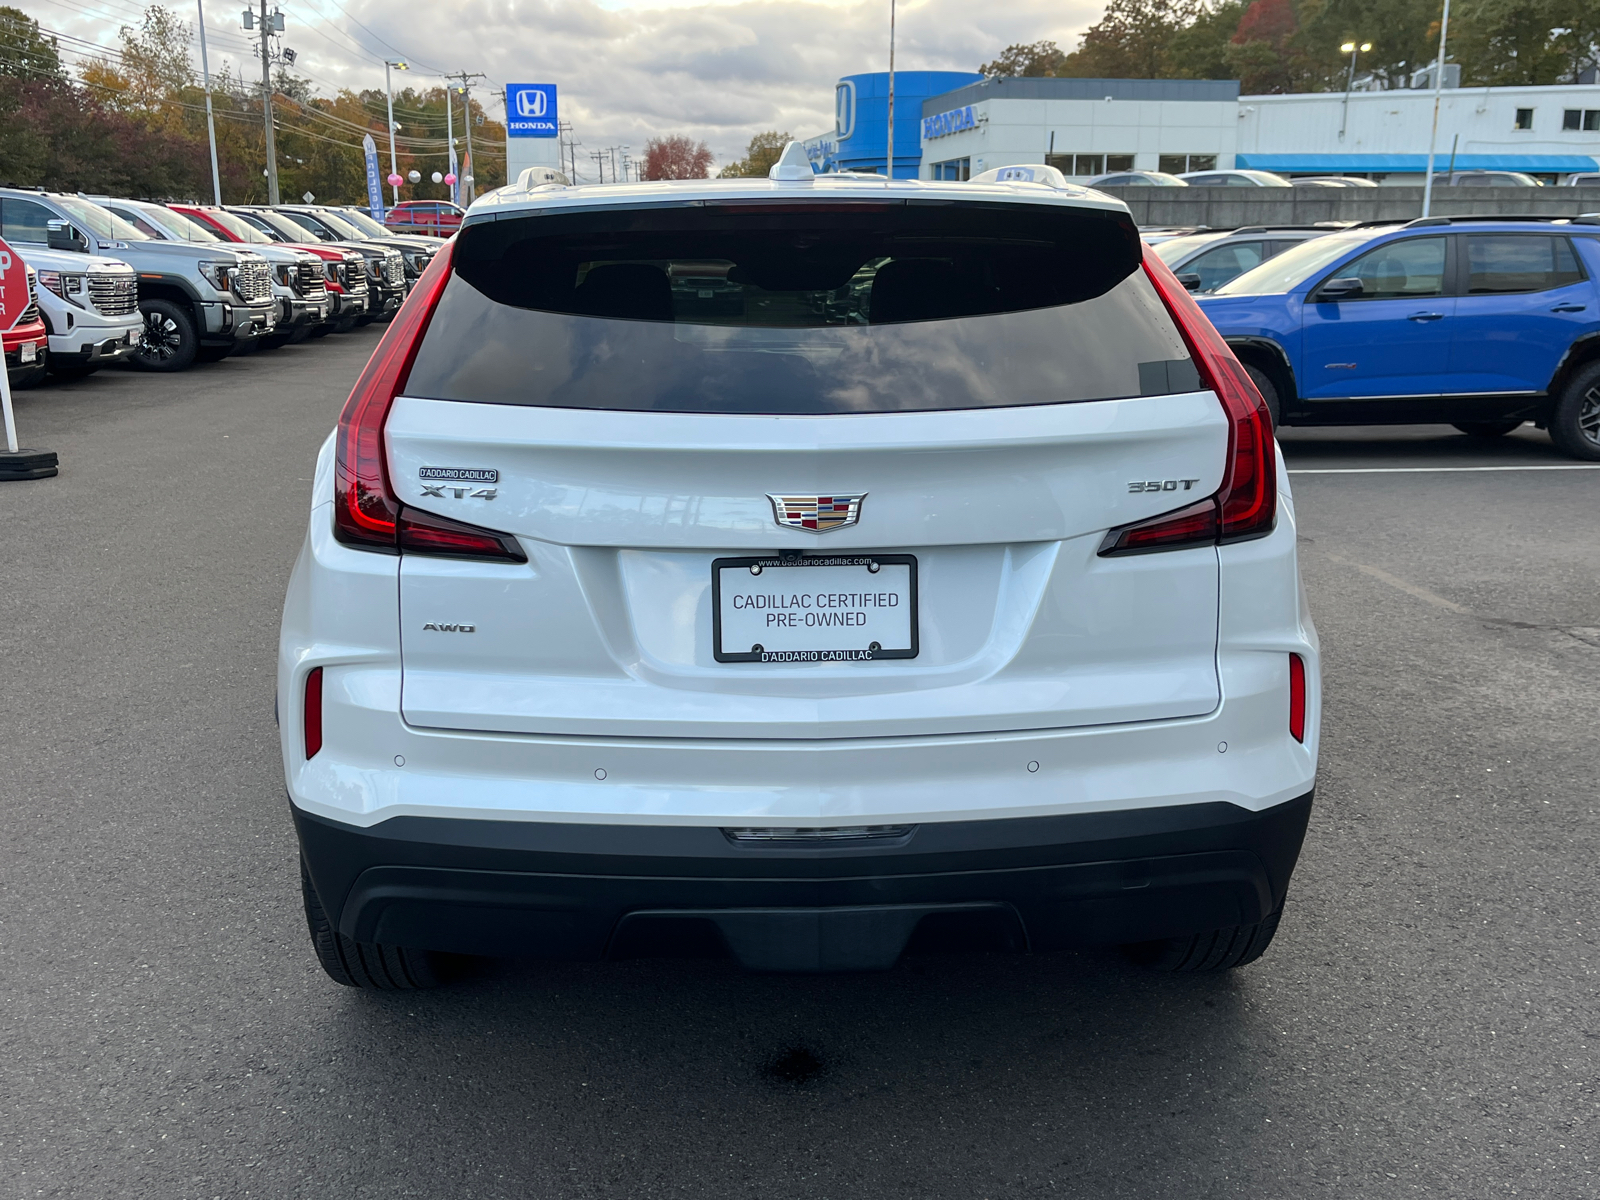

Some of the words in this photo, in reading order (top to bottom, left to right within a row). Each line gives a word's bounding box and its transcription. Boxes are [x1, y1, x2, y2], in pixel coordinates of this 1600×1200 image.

[923, 105, 975, 139] HONDA
[420, 469, 458, 478] D'ADDARIO
[459, 470, 495, 480] CADILLAC
[420, 484, 497, 500] XT4
[1128, 479, 1200, 493] 350T
[733, 594, 811, 609] CADILLAC
[816, 593, 899, 608] CERTIFIED
[766, 612, 866, 627] PRE-OWNED
[423, 622, 475, 633] AWD
[761, 652, 818, 662] D'ADDARIO
[821, 650, 873, 661] CADILLAC
